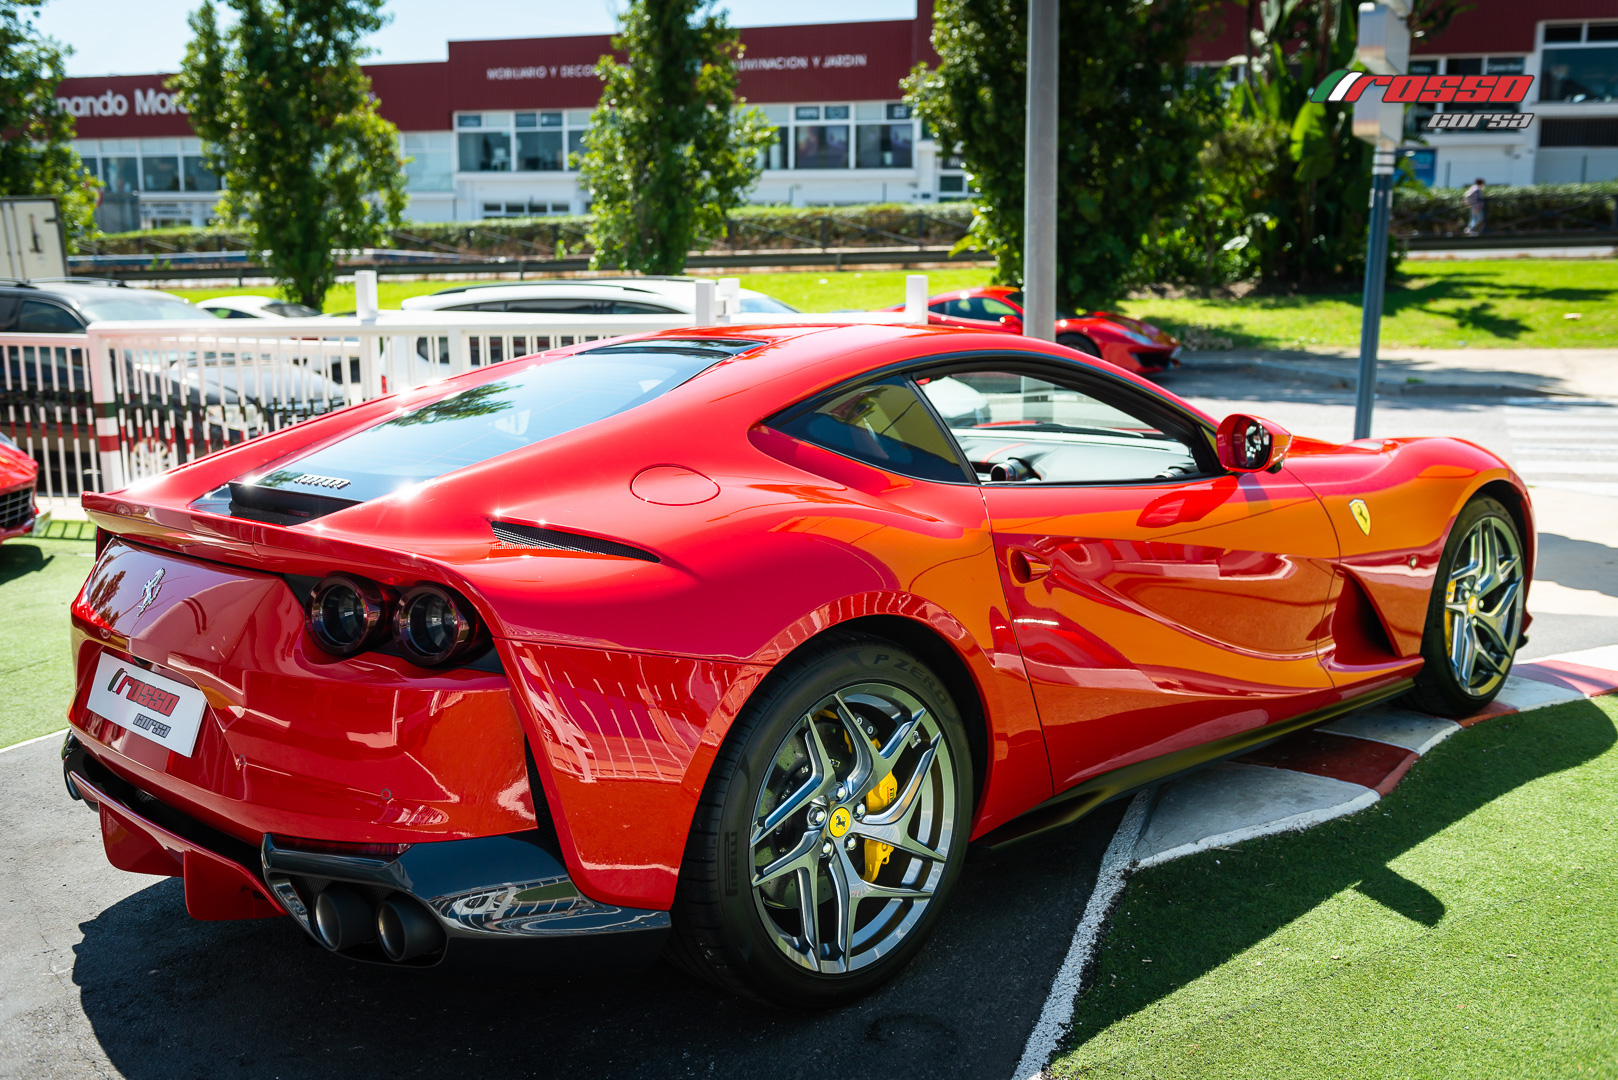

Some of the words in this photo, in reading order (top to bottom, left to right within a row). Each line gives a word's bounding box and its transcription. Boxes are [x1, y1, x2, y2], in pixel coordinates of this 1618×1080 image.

[486, 65, 548, 80] MOBILIARIO
[549, 65, 558, 79] Y
[730, 55, 808, 71] UMINACION
[811, 54, 822, 69] Y
[822, 52, 868, 69] JARDIN
[48, 88, 129, 117] nando
[873, 653, 891, 665] P
[893, 657, 950, 706] ZERO
[132, 712, 172, 739] corsa
